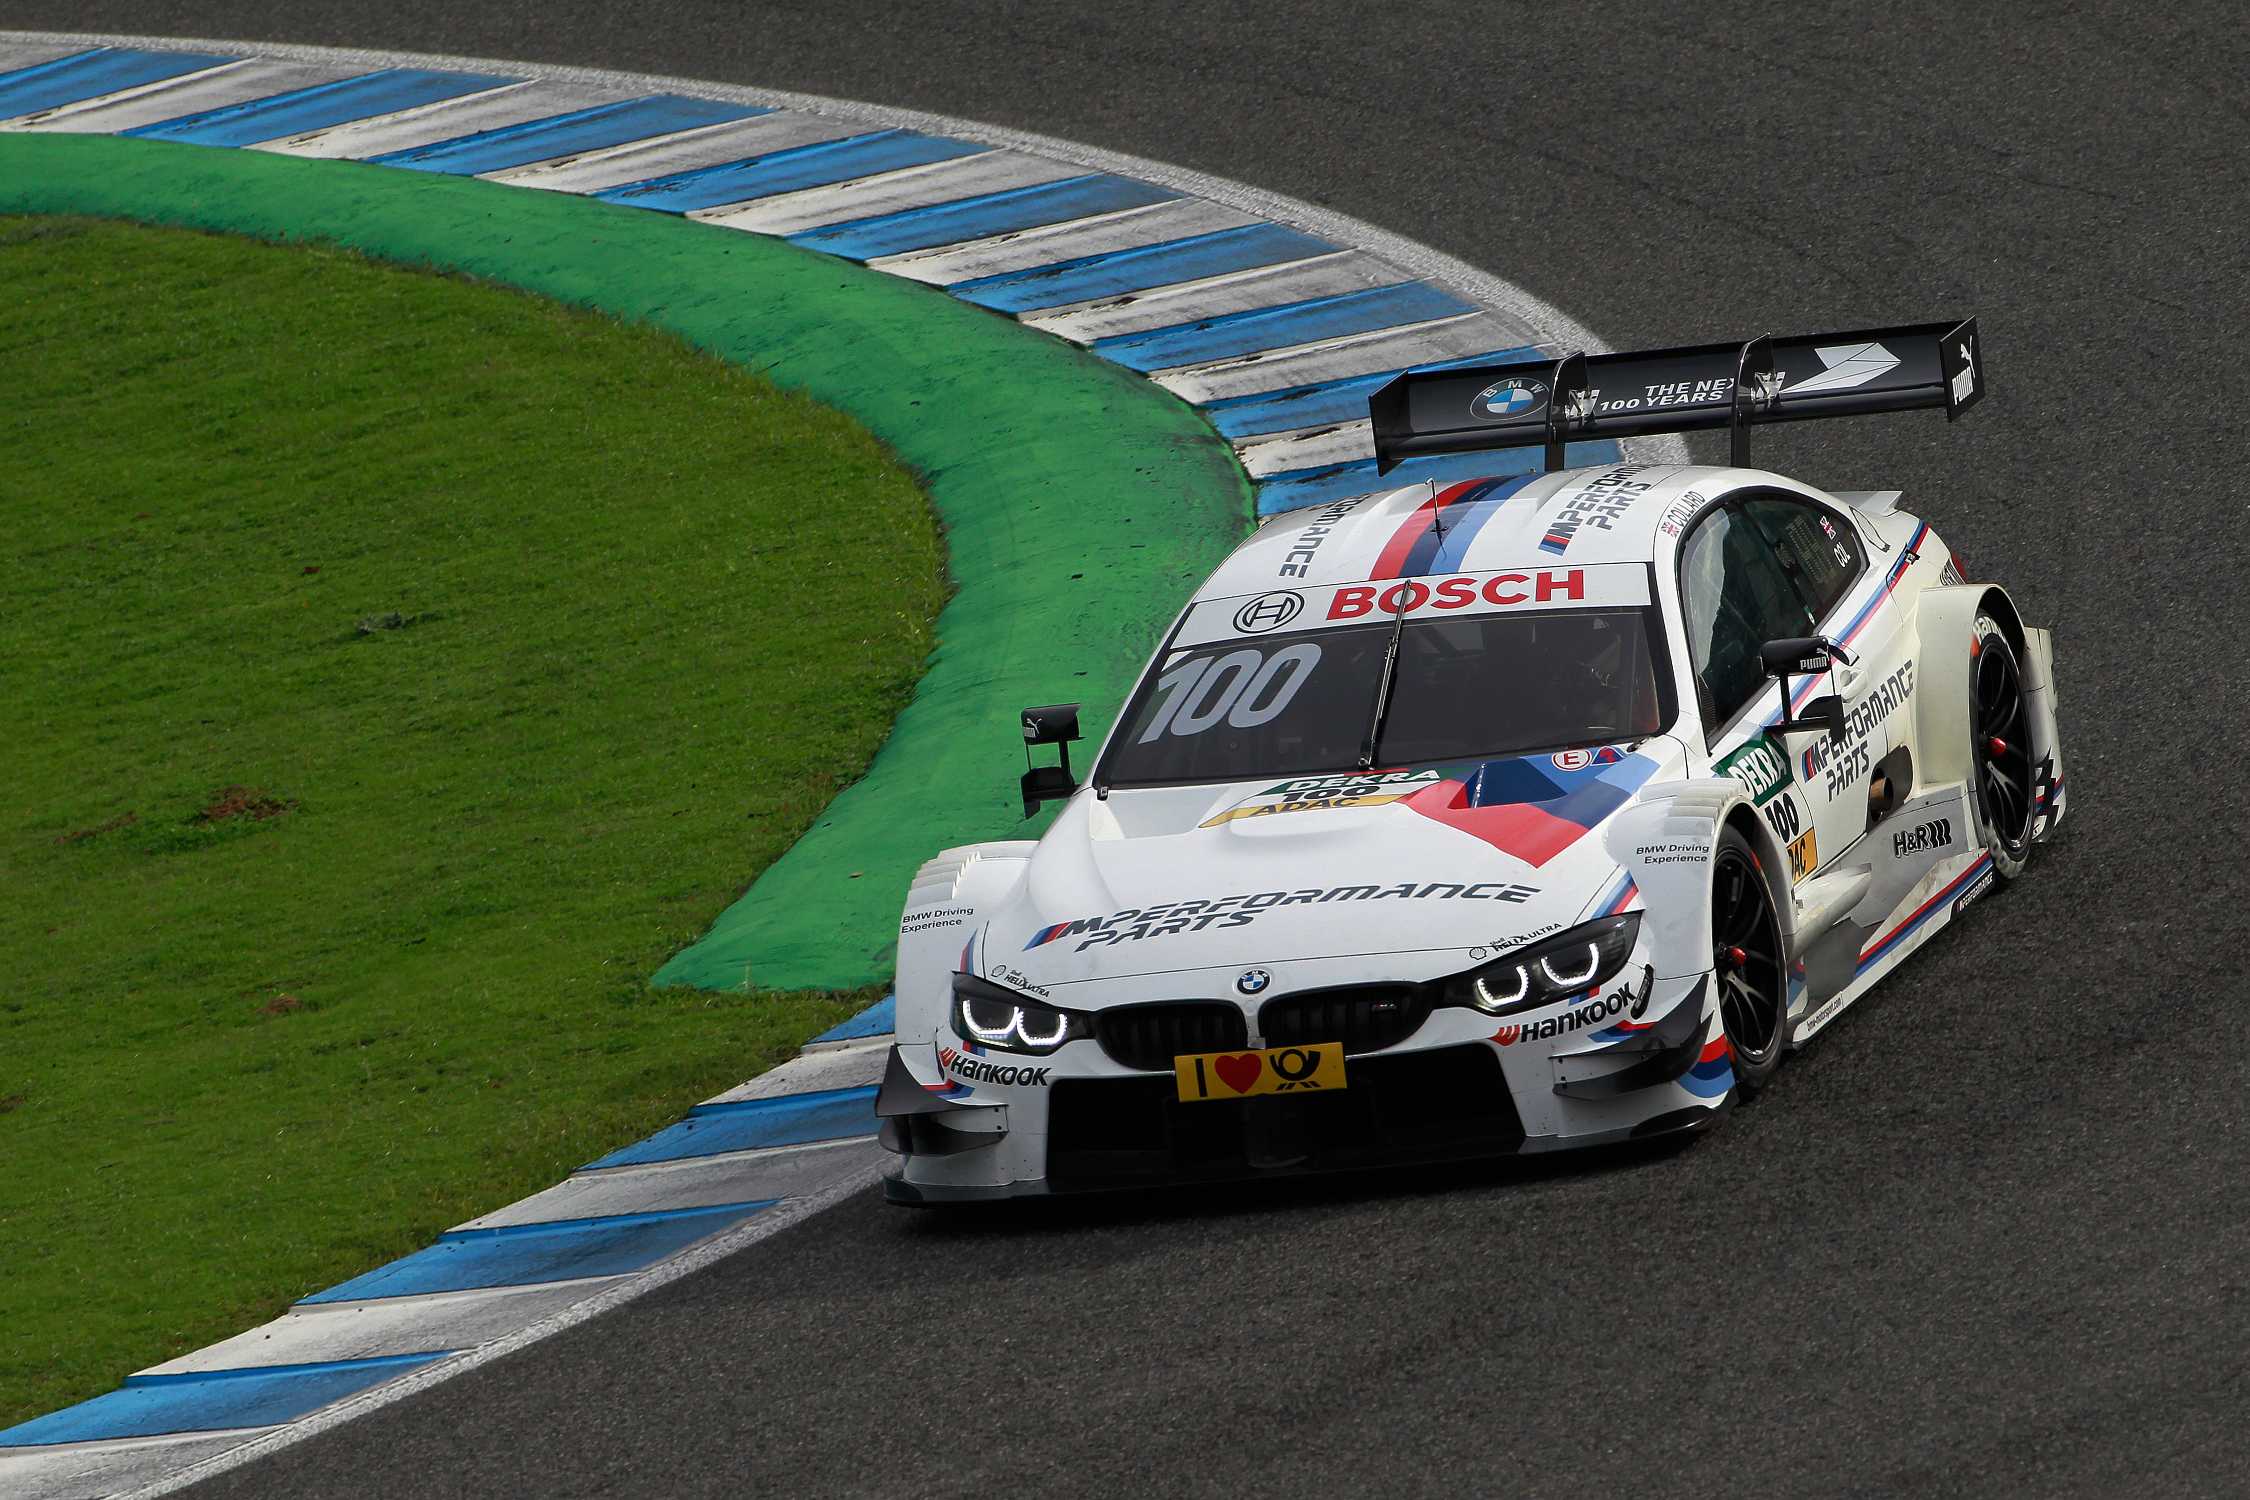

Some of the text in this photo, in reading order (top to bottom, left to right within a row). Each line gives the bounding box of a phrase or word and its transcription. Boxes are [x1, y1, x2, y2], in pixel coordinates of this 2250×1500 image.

[1482, 379, 1546, 398] BMW
[1645, 377, 1735, 397] THE NEX
[1600, 390, 1724, 411] 100 YEARS
[1586, 481, 1652, 531] PARTS
[1667, 490, 1706, 527] COLLARD
[1326, 568, 1585, 621] BOSCH
[1800, 656, 1828, 671] PUMA
[1138, 643, 1322, 745] 100
[1286, 769, 1440, 791] DEKRA
[1825, 740, 1870, 802] PARTS
[1282, 786, 1380, 803] 100
[1249, 797, 1360, 817] ADAC
[1765, 792, 1800, 843] 100
[1636, 844, 1710, 855] BMW Driving
[1787, 837, 1806, 881] DAC
[1644, 855, 1708, 865] Experience
[902, 907, 974, 924] BMW Driving
[901, 918, 962, 934] Experience
[1074, 909, 1266, 953] PARTS
[1528, 923, 1563, 938] ULTRA
